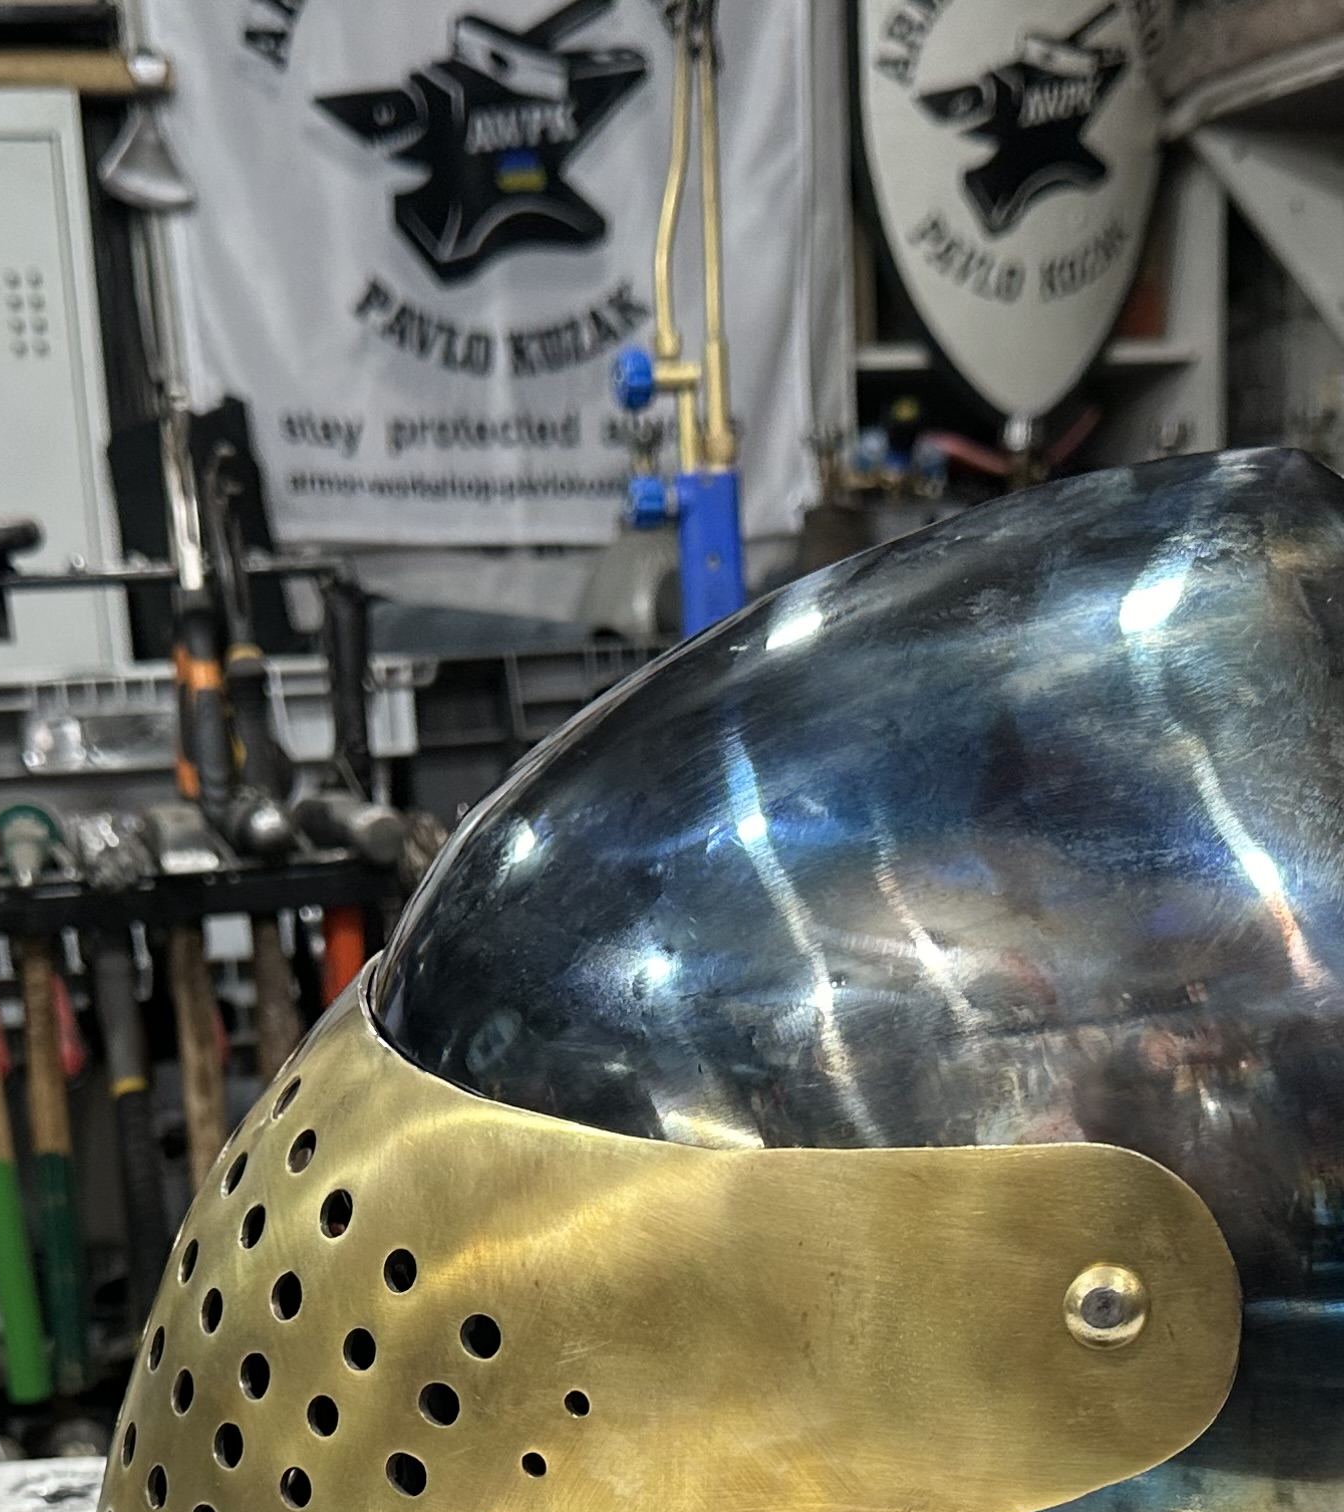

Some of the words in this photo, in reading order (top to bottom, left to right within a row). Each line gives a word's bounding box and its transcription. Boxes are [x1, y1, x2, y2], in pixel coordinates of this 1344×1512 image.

[353, 278, 495, 379] PAVLO
[505, 279, 649, 379] KOZAK
[278, 410, 363, 458] stay
[386, 410, 580, 454] protected
